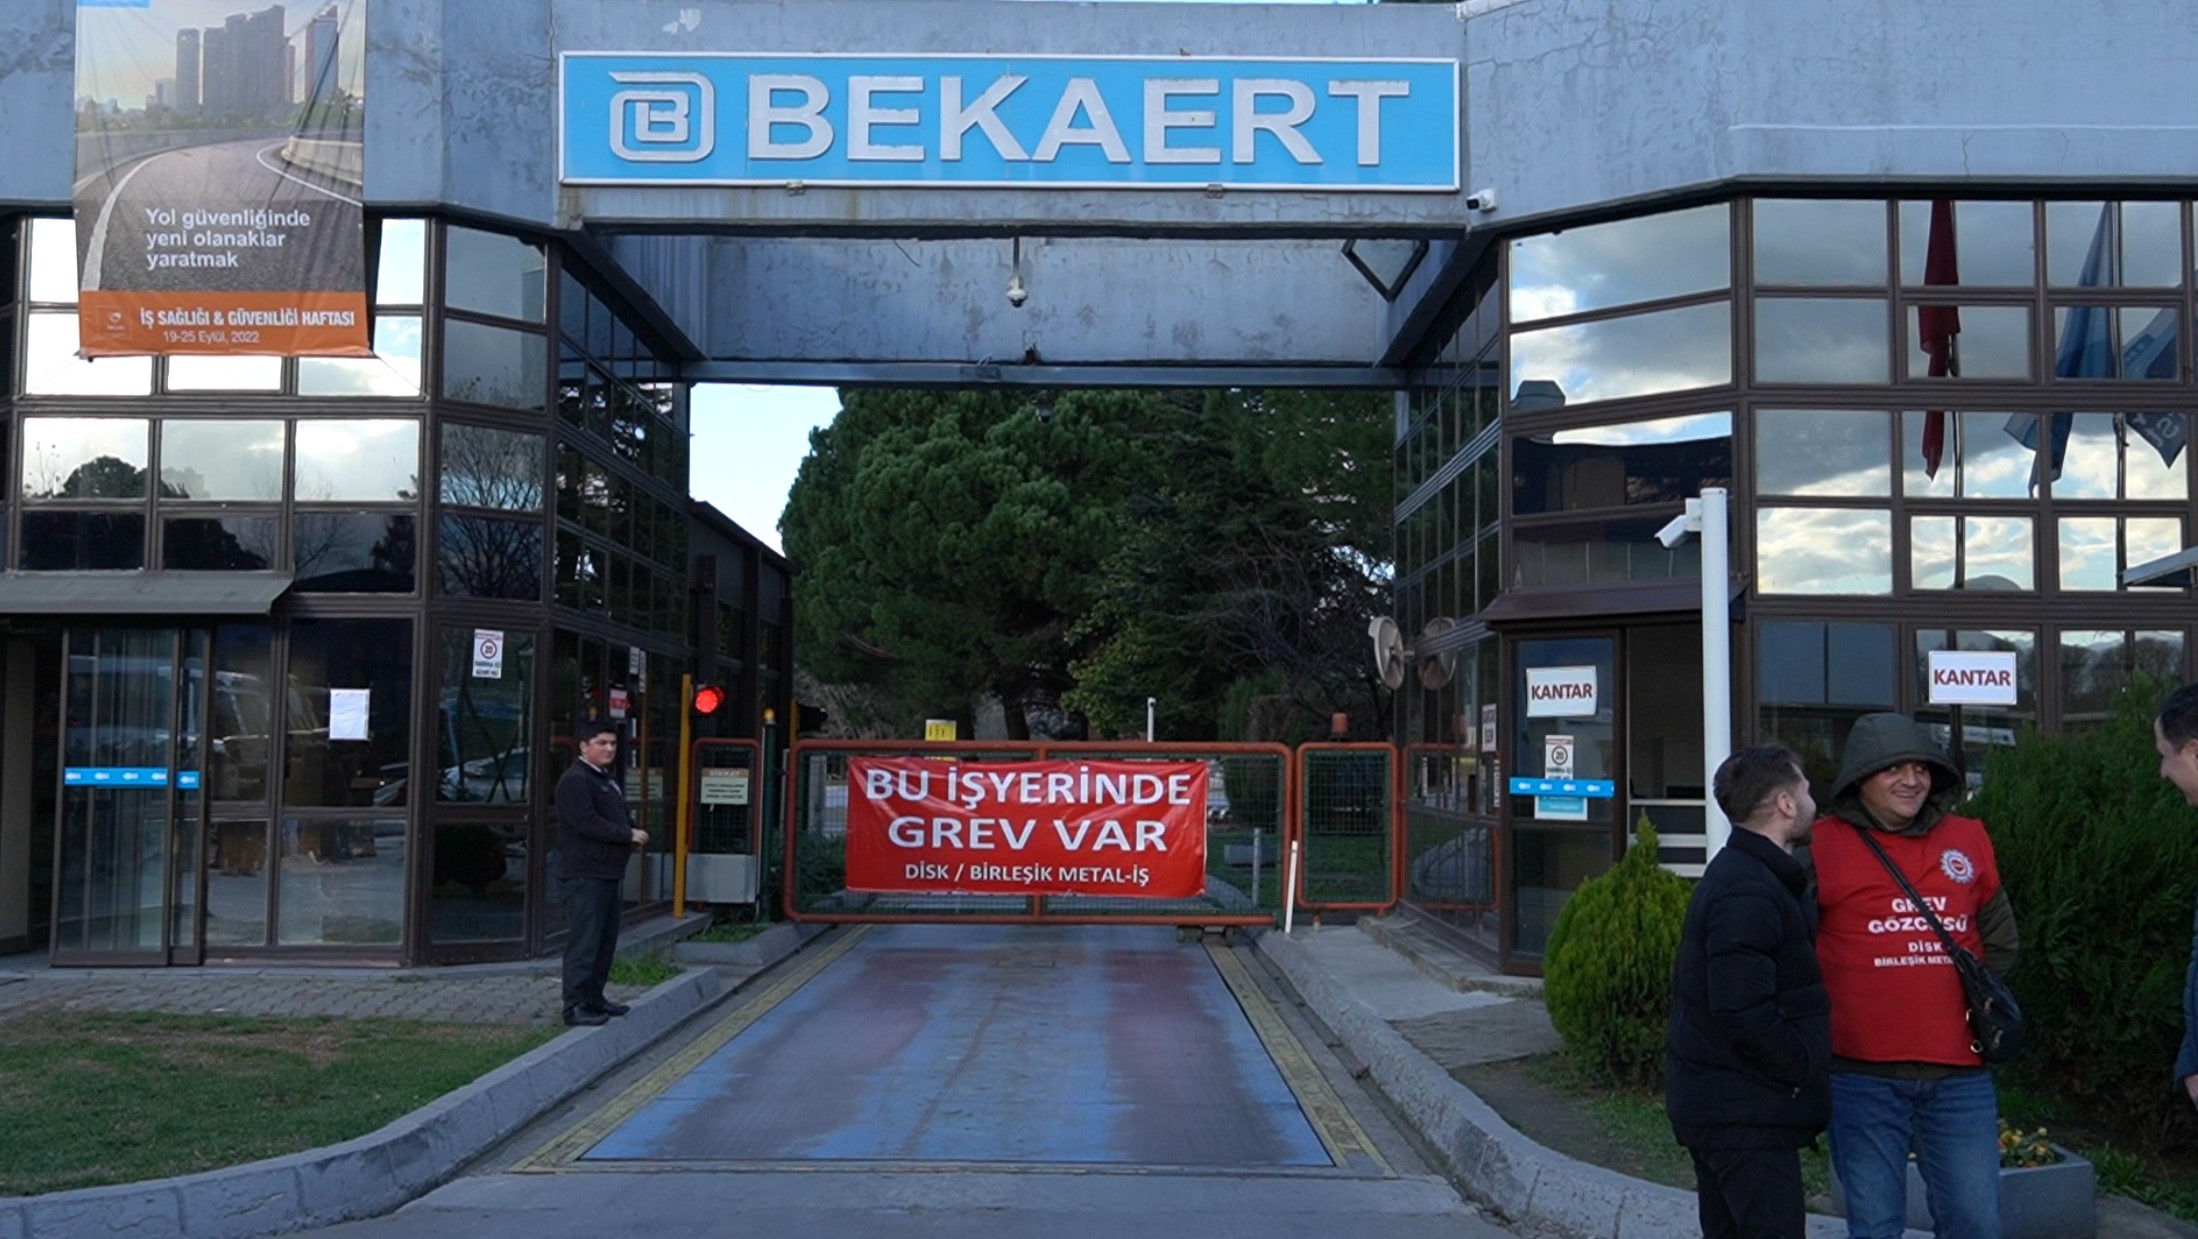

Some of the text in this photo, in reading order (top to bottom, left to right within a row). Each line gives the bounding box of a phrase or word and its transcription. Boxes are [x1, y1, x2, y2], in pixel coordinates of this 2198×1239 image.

[748, 75, 1411, 167] BEKAERT
[146, 208, 311, 230] Yol güvenliğinde
[146, 230, 286, 249] yeni olanaklar
[146, 252, 239, 270] yaratmak
[140, 307, 355, 329] İŞ SAĞLIĞI & GÜVENLİĞİ HAFTASI
[163, 331, 196, 343] 19-25
[231, 331, 260, 343] 2022
[1934, 669, 2011, 686] KANTAR
[1531, 683, 1593, 700] KANTAR
[866, 766, 1192, 810] BU İŞYERİNDE
[888, 816, 1168, 852] GREV VAR
[905, 861, 1150, 887] DİSK / BİRLEŞİK METAL-İŞ
[1907, 940, 1943, 953] DİSK
